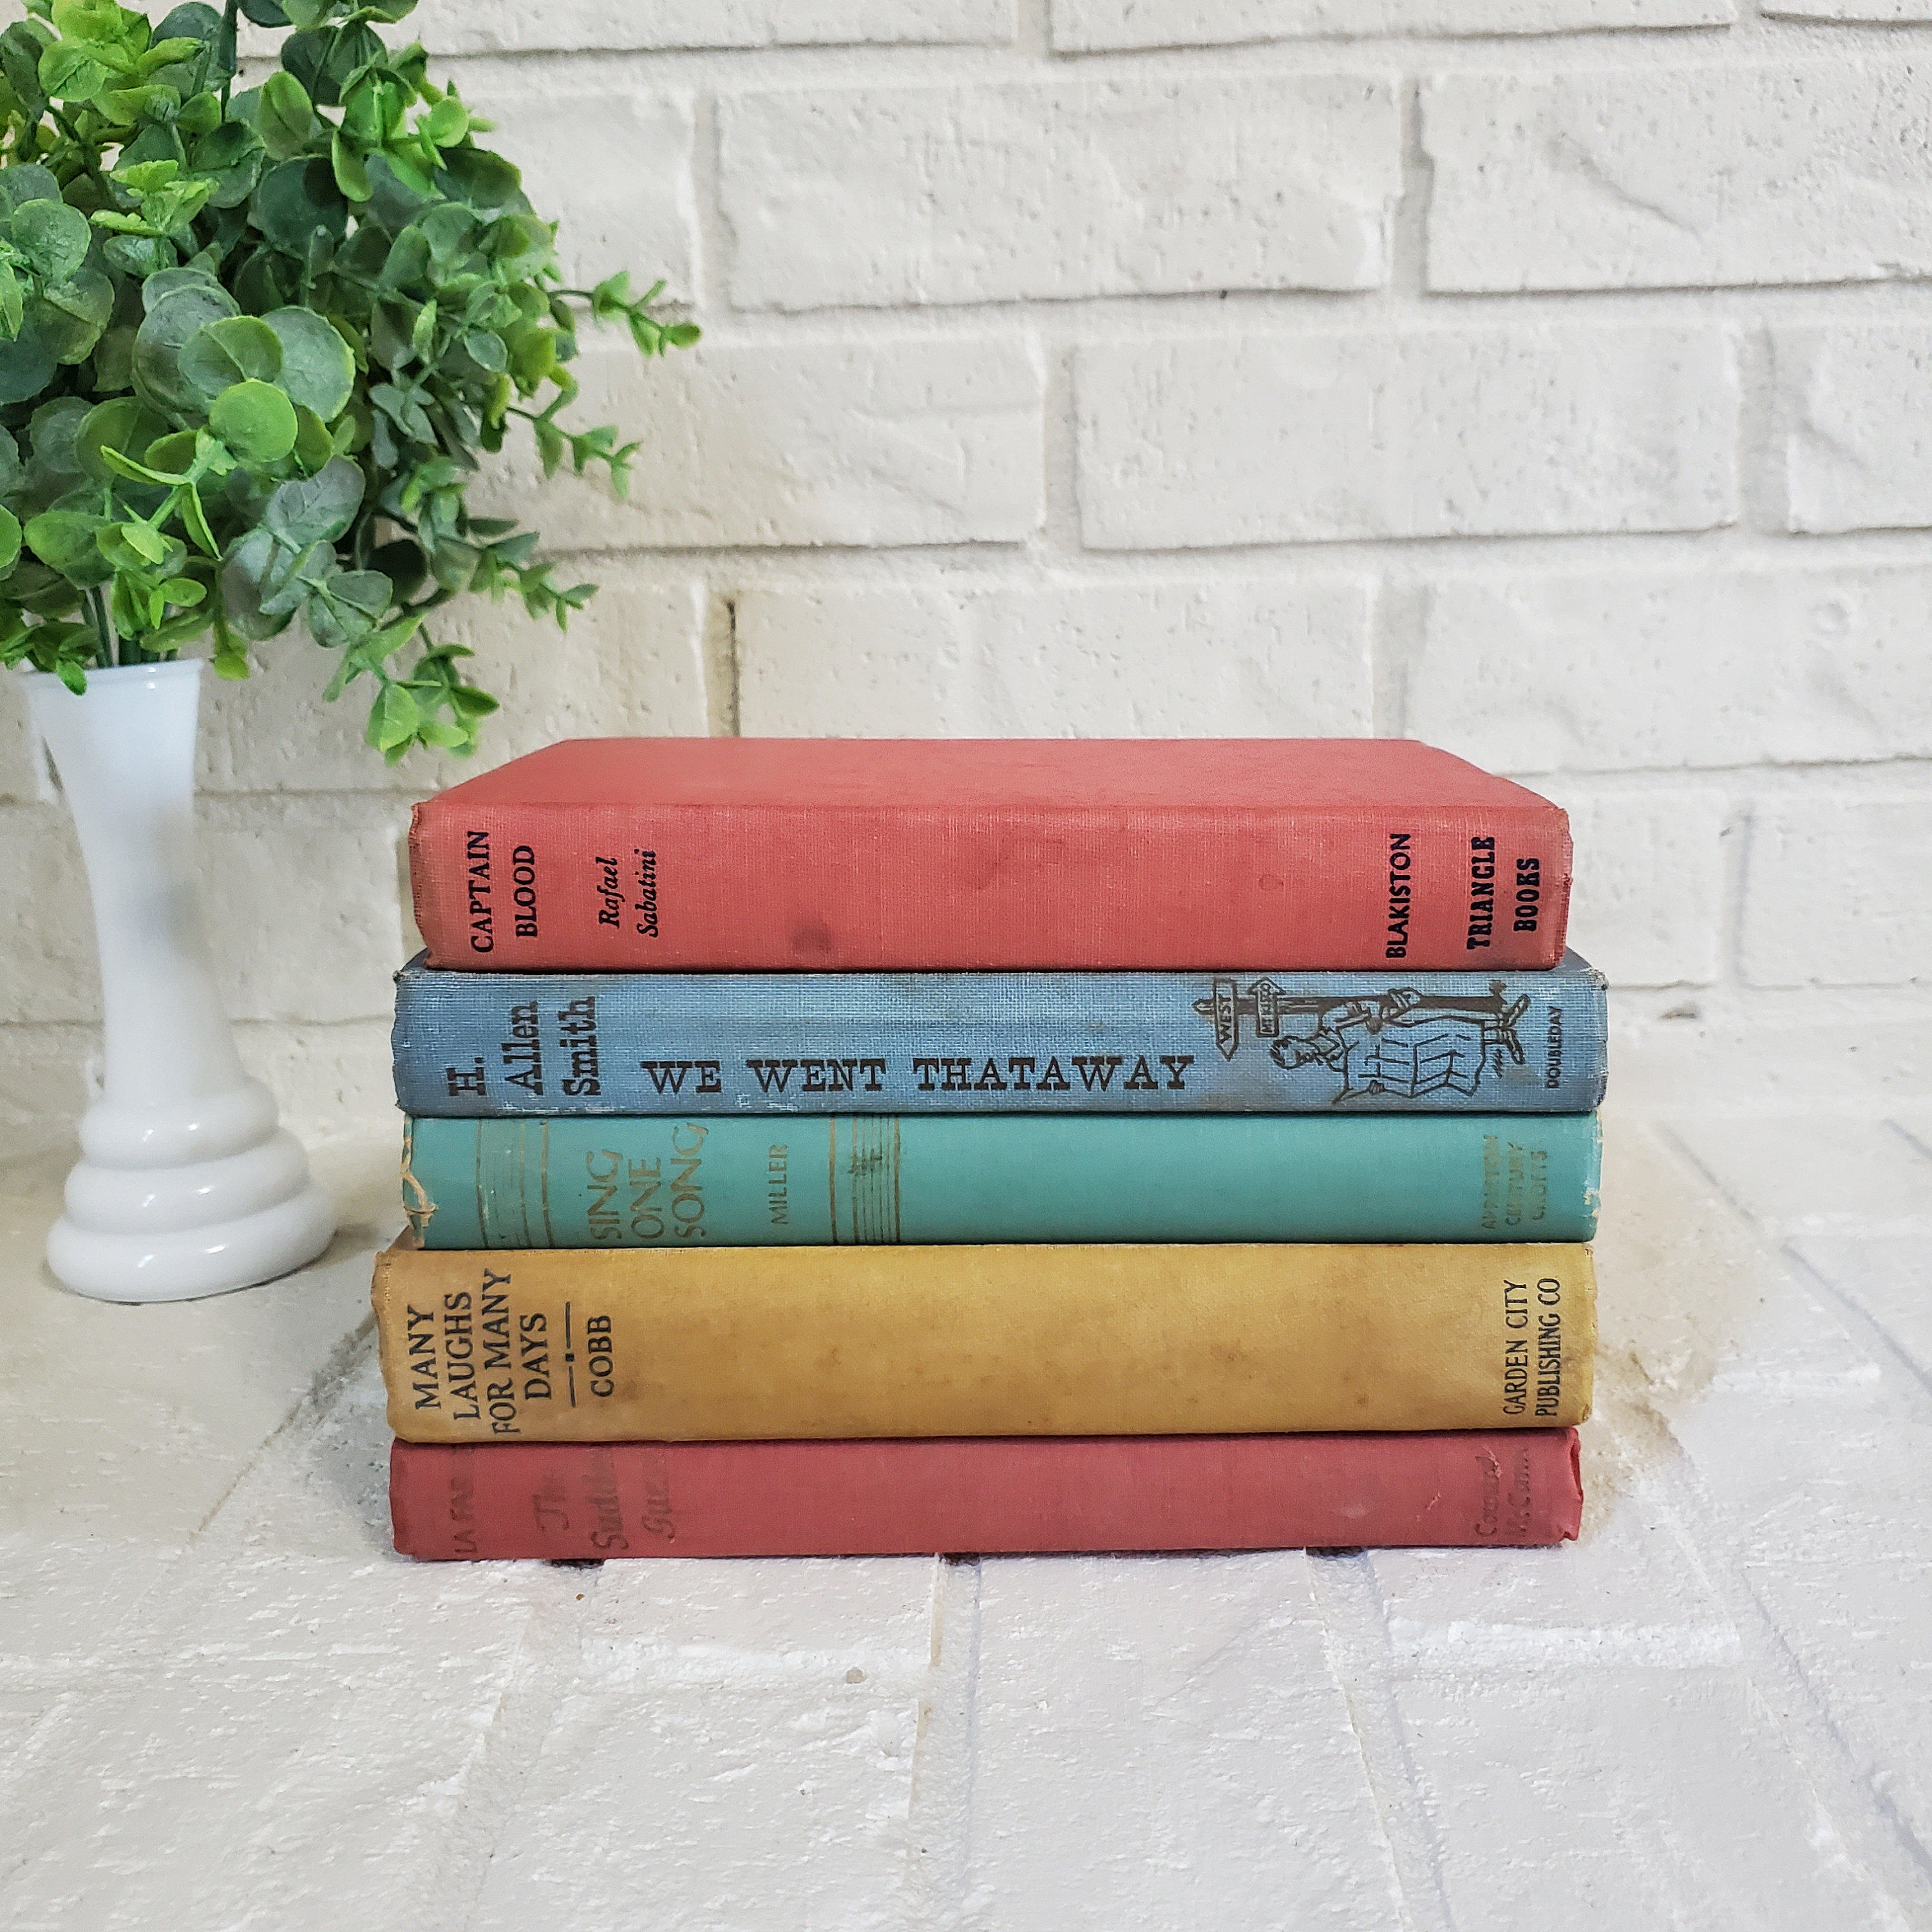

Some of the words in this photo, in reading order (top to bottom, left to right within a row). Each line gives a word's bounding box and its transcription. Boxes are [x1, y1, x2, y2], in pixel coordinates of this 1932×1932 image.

[467, 830, 495, 952] CAPTAIN
[512, 844, 538, 938] BLOOD
[595, 856, 625, 929] Rafael
[634, 848, 659, 938] Sabatini
[1385, 833, 1412, 958] BLAKISTON
[1466, 836, 1495, 951] TRIANGLE
[1513, 857, 1540, 932] BOOKS
[502, 1000, 544, 1095] Allen
[558, 996, 601, 1095] Smith
[1217, 994, 1233, 1045] WEST
[1546, 1005, 1562, 1089] DOUBLEDAY
[446, 1057, 486, 1096] H.
[639, 1060, 722, 1094] WE
[746, 1059, 887, 1094] WENT
[912, 1056, 1195, 1092] THATAWAY
[586, 1149, 623, 1240] SING
[629, 1157, 665, 1239] ONE
[670, 1122, 709, 1238] SONG
[768, 1144, 788, 1225] MILLER
[482, 1267, 512, 1370] MANY
[1502, 1279, 1528, 1329] CITY
[1537, 1278, 1561, 1306] CO
[407, 1303, 442, 1410] MANY
[444, 1291, 482, 1420] LAUGHS
[519, 1312, 553, 1401] DAYS
[587, 1314, 615, 1397] COBB
[1502, 1340, 1528, 1415] GARDEN
[1534, 1312, 1562, 1417] PUBLISHING
[486, 1377, 522, 1435] FOR
